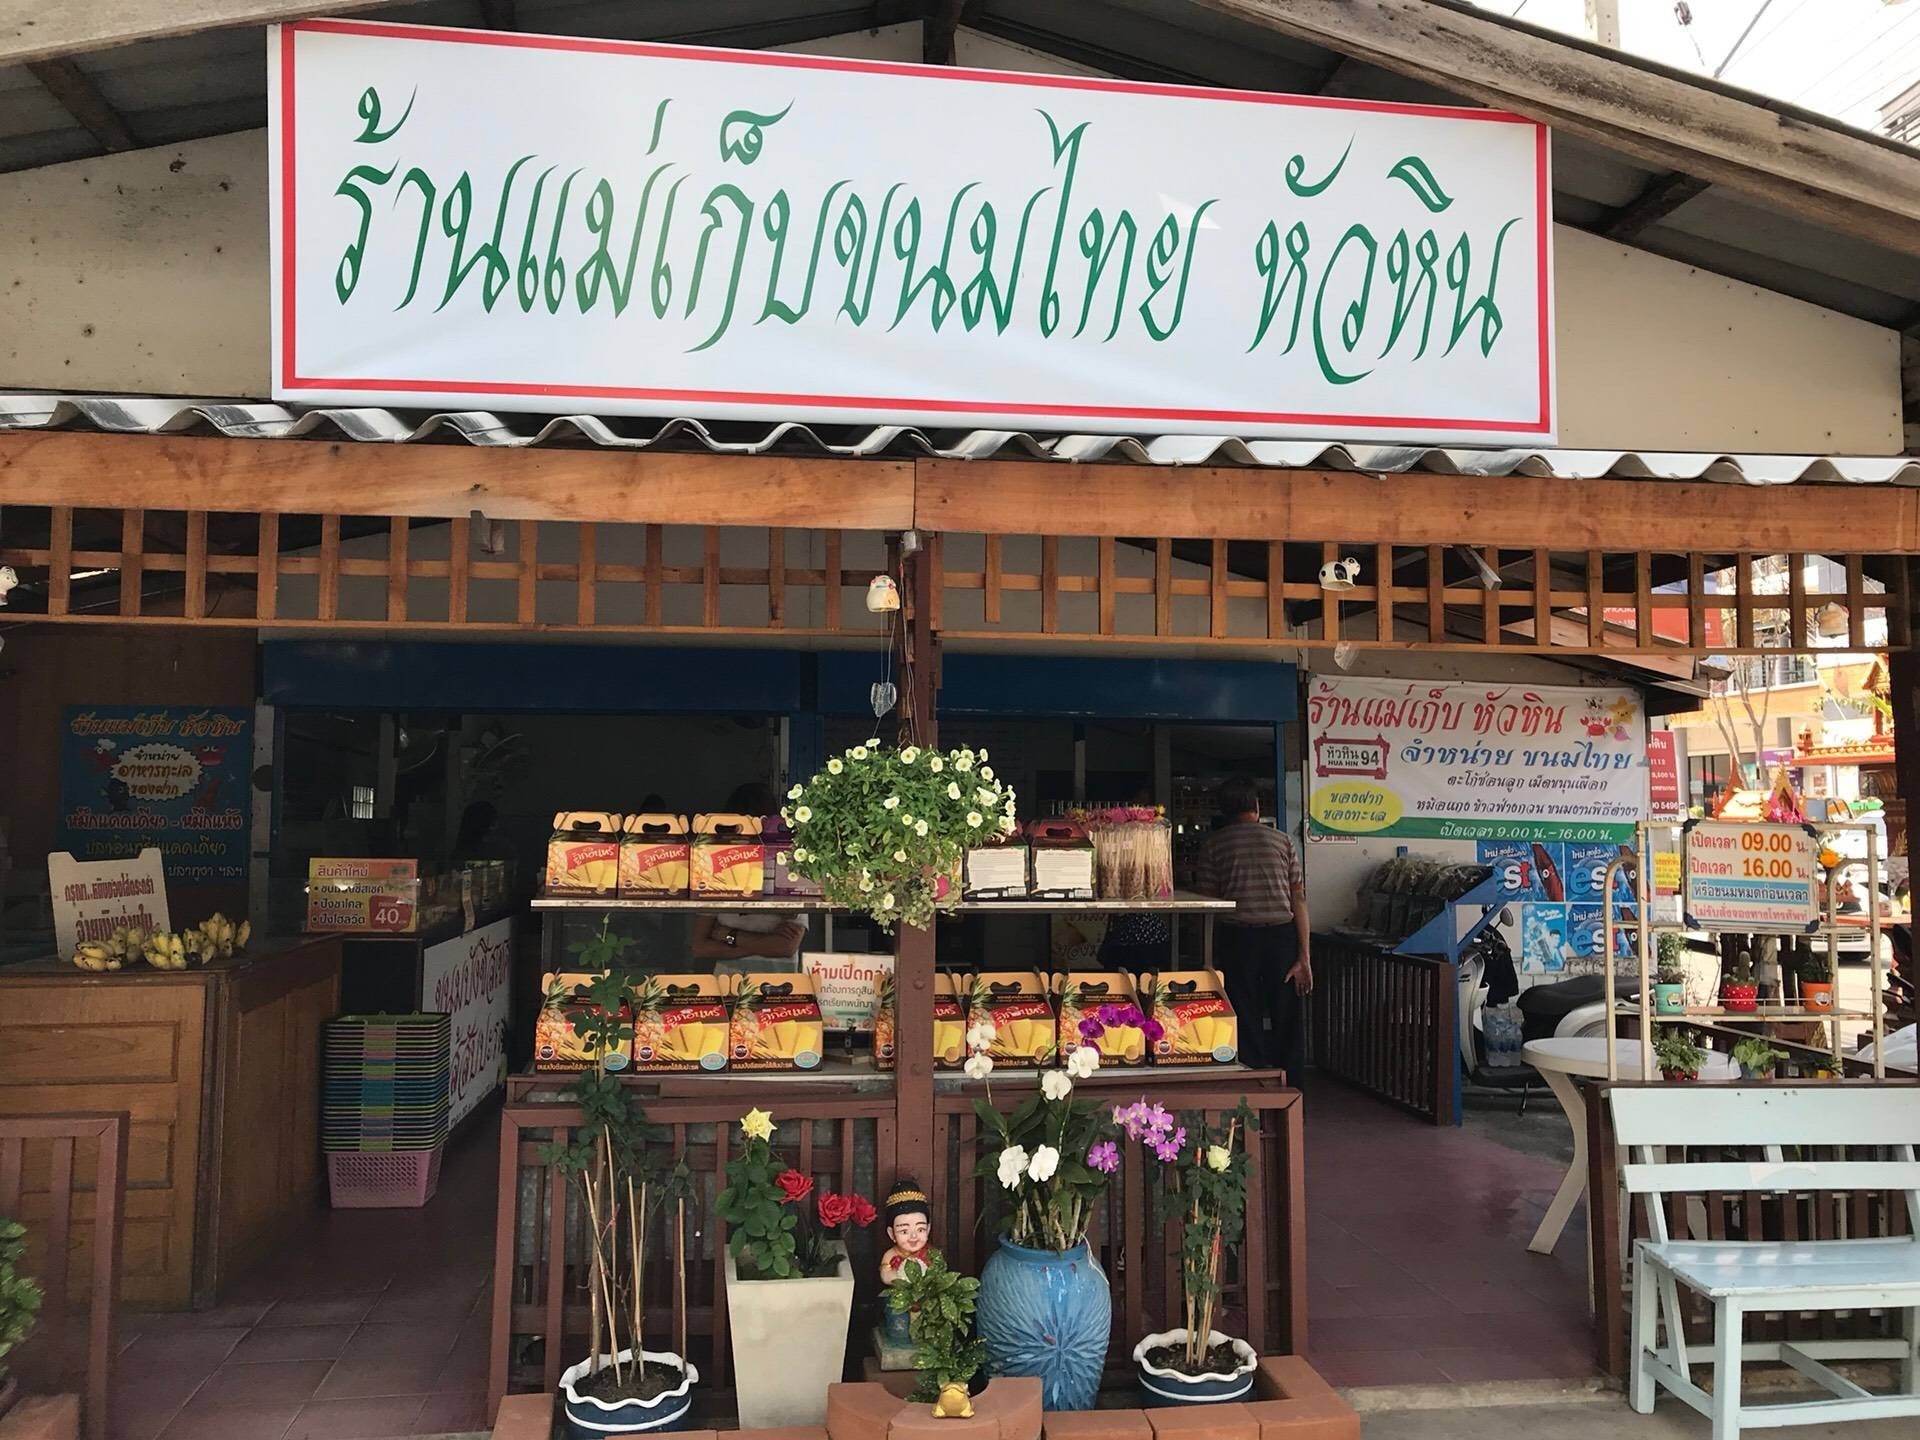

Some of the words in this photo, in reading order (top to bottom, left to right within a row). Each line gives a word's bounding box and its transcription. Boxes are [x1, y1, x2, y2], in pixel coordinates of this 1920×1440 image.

[334, 84, 1221, 353] ร้านแม่เก็บขนมไทย
[1245, 131, 1523, 385] หัวหิน
[1308, 682, 1467, 733] ร้านแม่เก็บ
[1473, 686, 1571, 738] หัวหิน
[1360, 750, 1380, 766] 94
[1400, 738, 1515, 768] จำหน่าย
[1523, 741, 1635, 772] ขนมไทย
[1330, 790, 1384, 806] ของฝาก
[1323, 810, 1387, 823] ของทะเล
[1440, 821, 1493, 838] เปิดเวลา
[1498, 828, 1530, 839] 9.00
[1691, 831, 1737, 849] เปิดเวลา
[1741, 831, 1792, 853] 09.00
[1796, 842, 1809, 852] น.
[1691, 858, 1733, 876] ปิดเวลา
[1743, 858, 1792, 879] 16.00
[1796, 867, 1809, 878] น.
[1694, 880, 1808, 901] หรือขนมหมดก่อนเวลา
[375, 908, 399, 924] 40
